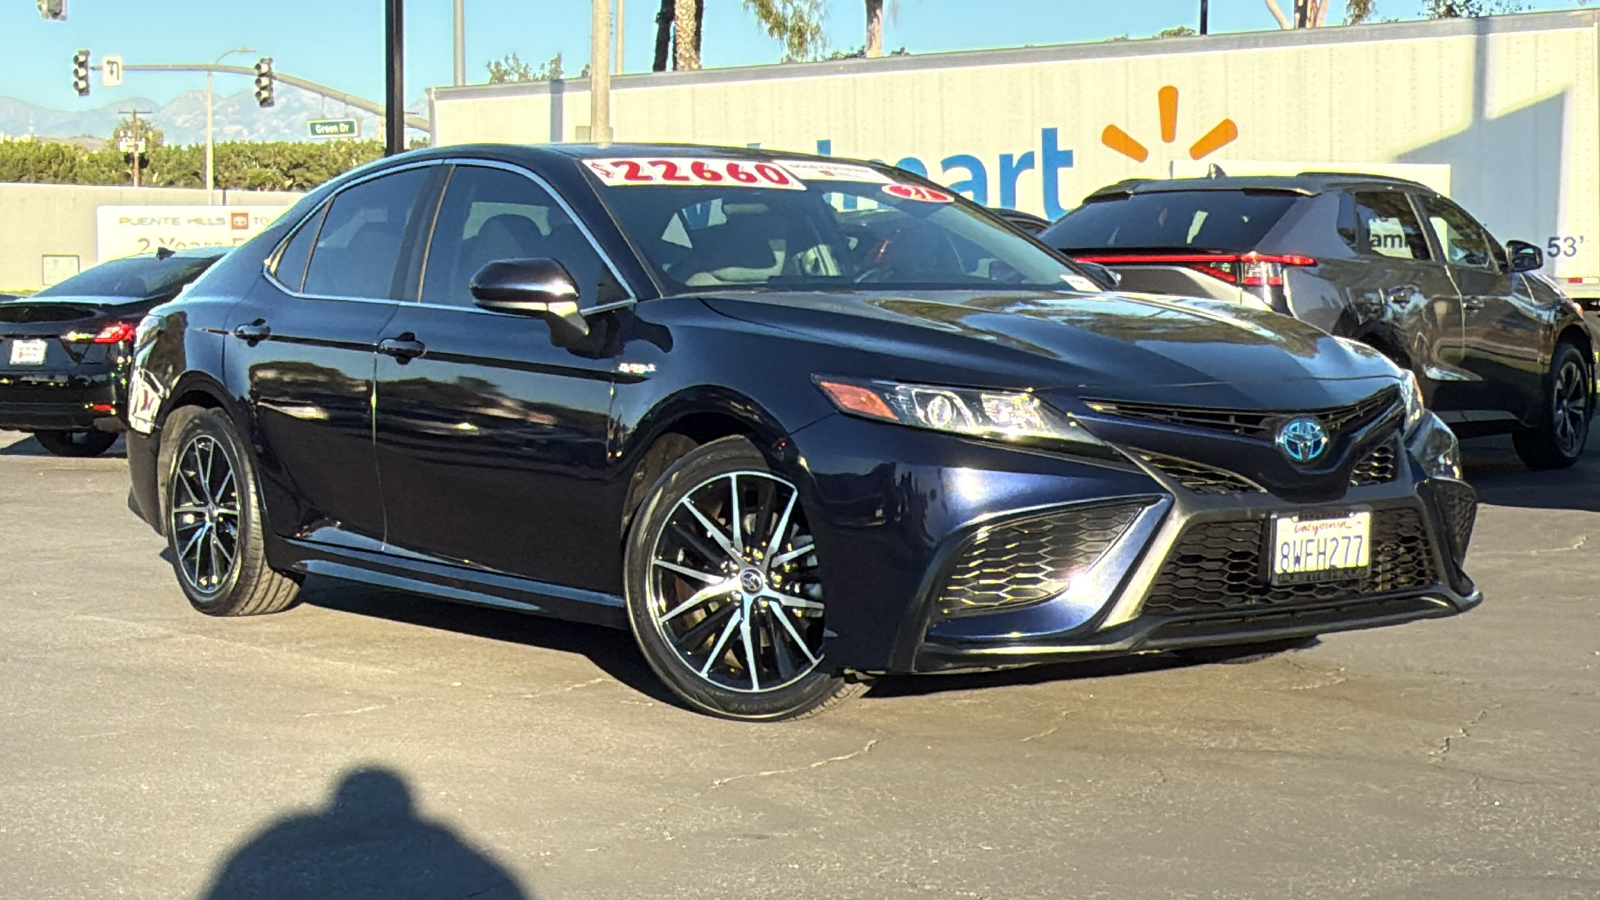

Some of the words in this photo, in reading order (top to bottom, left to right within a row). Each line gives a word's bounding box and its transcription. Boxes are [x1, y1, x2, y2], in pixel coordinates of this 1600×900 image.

[315, 124, 339, 134] Green
[340, 122, 349, 133] Dr
[590, 160, 790, 185] $22660
[119, 217, 181, 226] PUENTE
[187, 217, 226, 226] HILLS
[1547, 235, 1584, 258] 53'
[1280, 535, 1363, 572] 8WFH277
